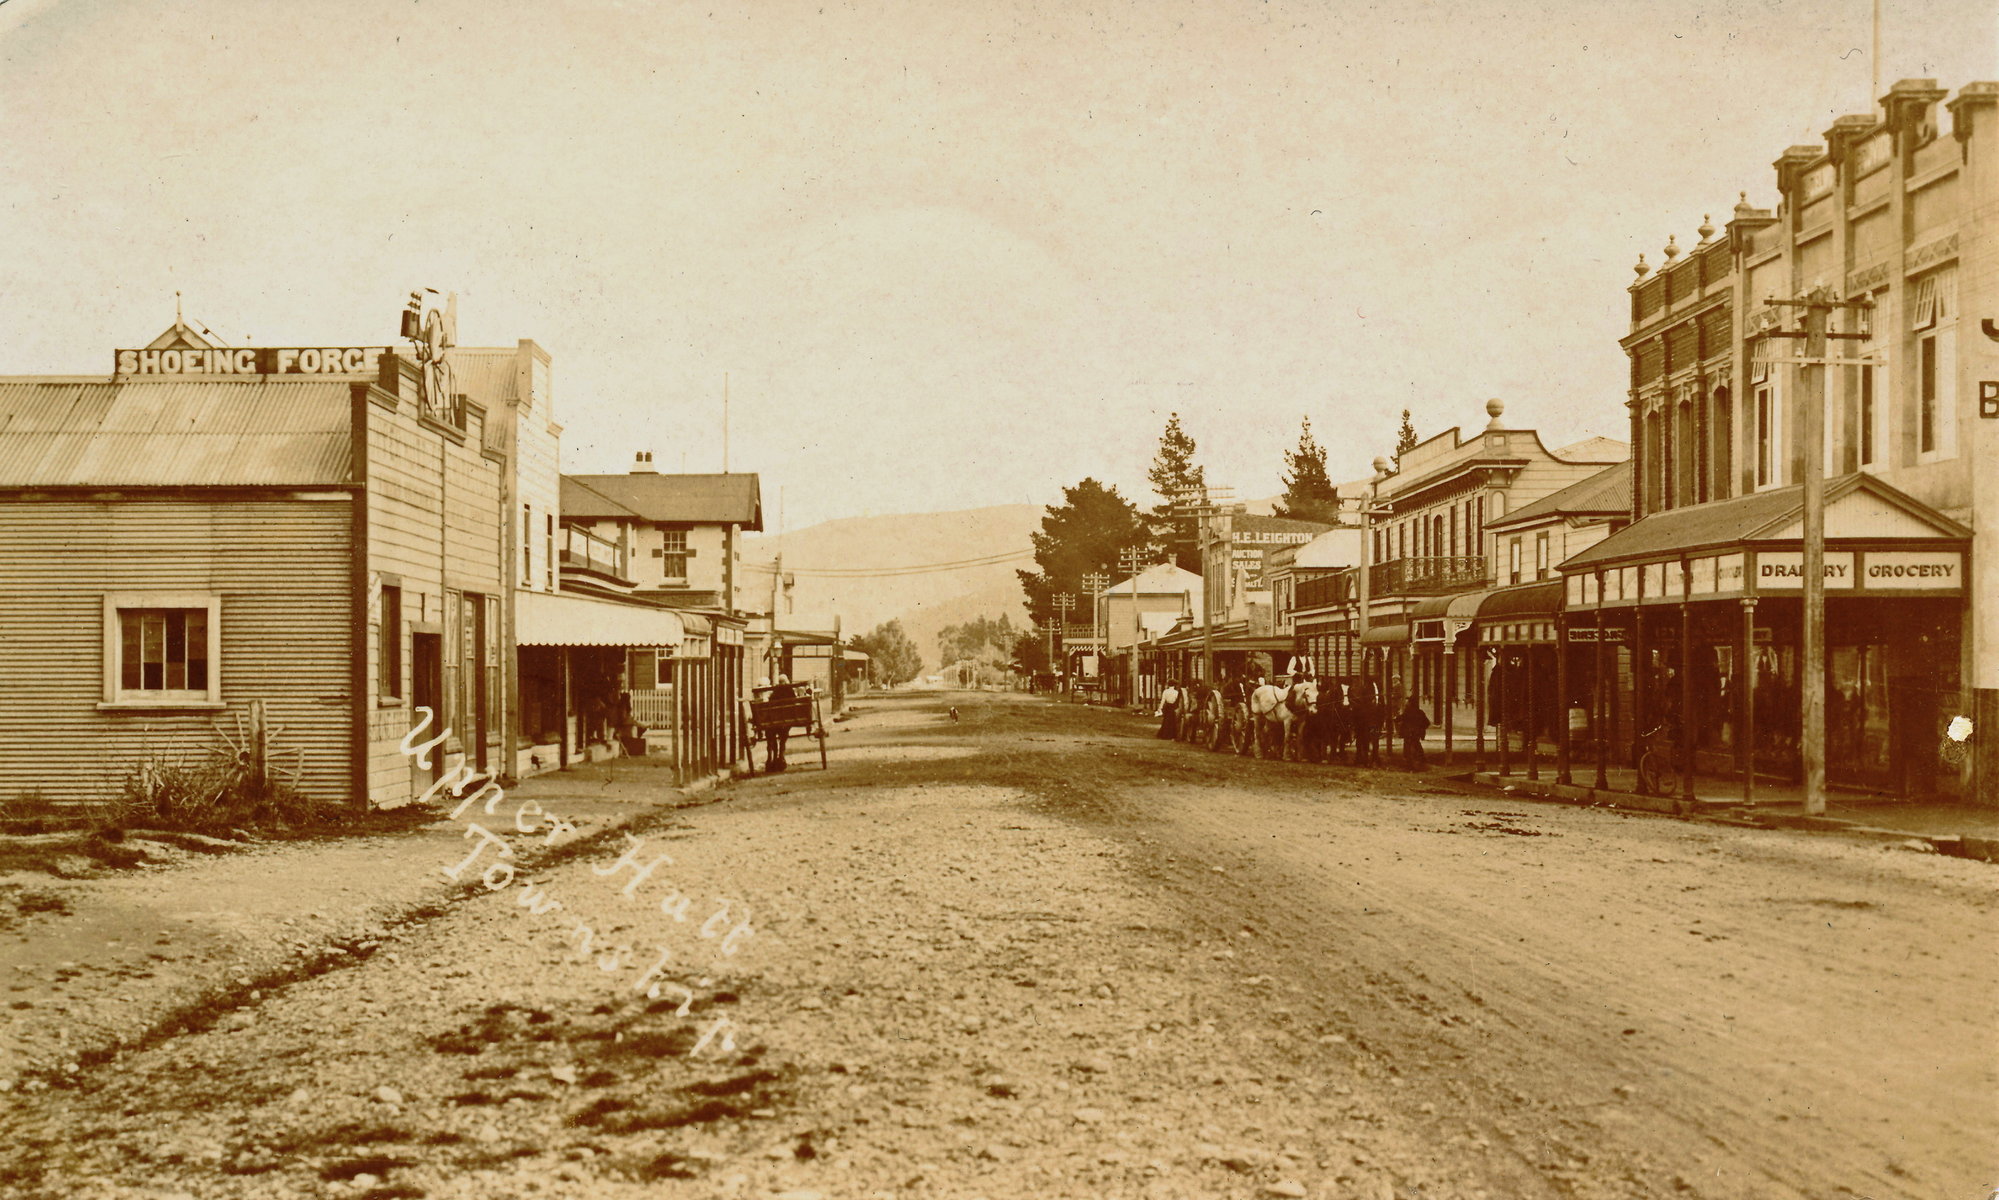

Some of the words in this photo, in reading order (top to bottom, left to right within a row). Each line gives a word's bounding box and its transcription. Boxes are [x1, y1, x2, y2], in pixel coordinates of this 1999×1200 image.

[118, 349, 256, 374] SHOEING
[278, 347, 386, 374] FORGE
[1232, 549, 1264, 559] AUCTION
[1232, 560, 1262, 570] SALES
[1761, 564, 1848, 578] DRARY
[1868, 563, 1955, 578] GROCERY
